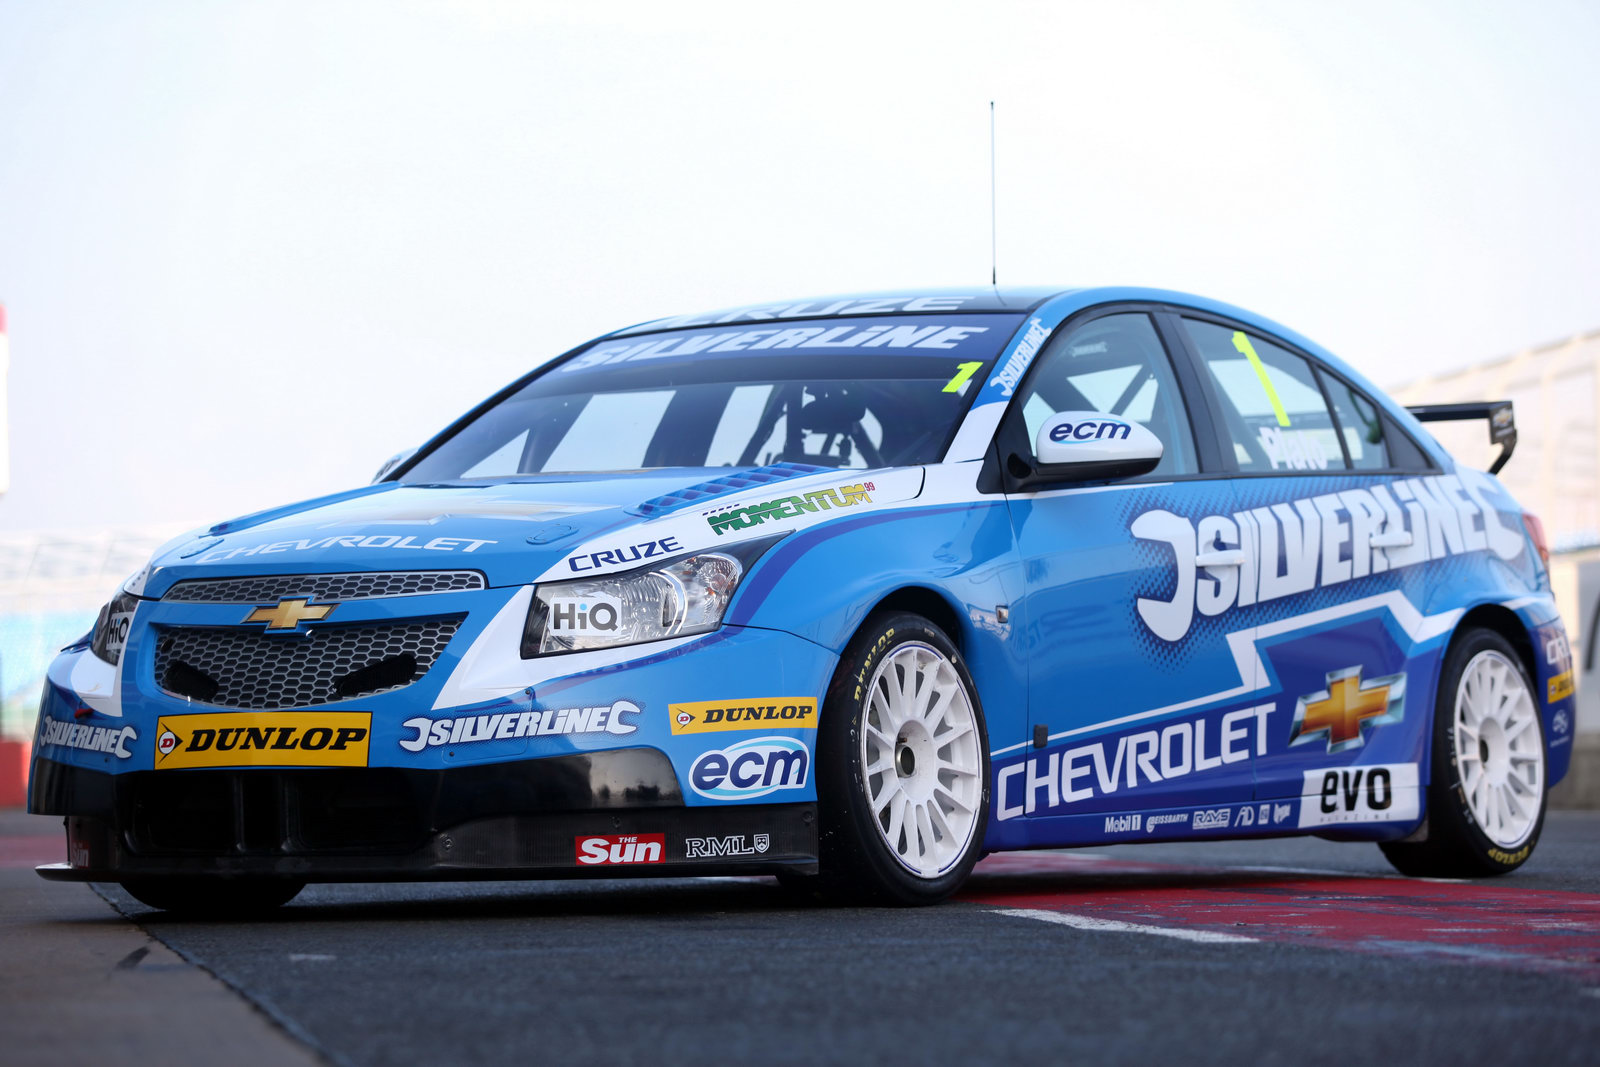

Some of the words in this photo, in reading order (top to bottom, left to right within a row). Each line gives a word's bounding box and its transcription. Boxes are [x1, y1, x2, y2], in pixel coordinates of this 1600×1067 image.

[941, 361, 983, 393] 1
[1231, 331, 1291, 427] 1
[1049, 418, 1132, 442] ecm
[707, 483, 873, 536] MOMENTUM
[863, 481, 876, 492] 99
[196, 534, 498, 564] CHEVROLET
[568, 536, 684, 573] CRUZE
[552, 602, 618, 632] HiQ
[702, 704, 813, 724] DUNLOP
[185, 726, 367, 752] DUNLOP
[692, 748, 807, 791] ecm
[997, 702, 1277, 821] CHEVROLET
[1320, 767, 1391, 814] evo
[1104, 815, 1131, 833] Mobil
[578, 838, 662, 864] Sun
[618, 836, 638, 844] THE
[685, 835, 755, 858] RML
